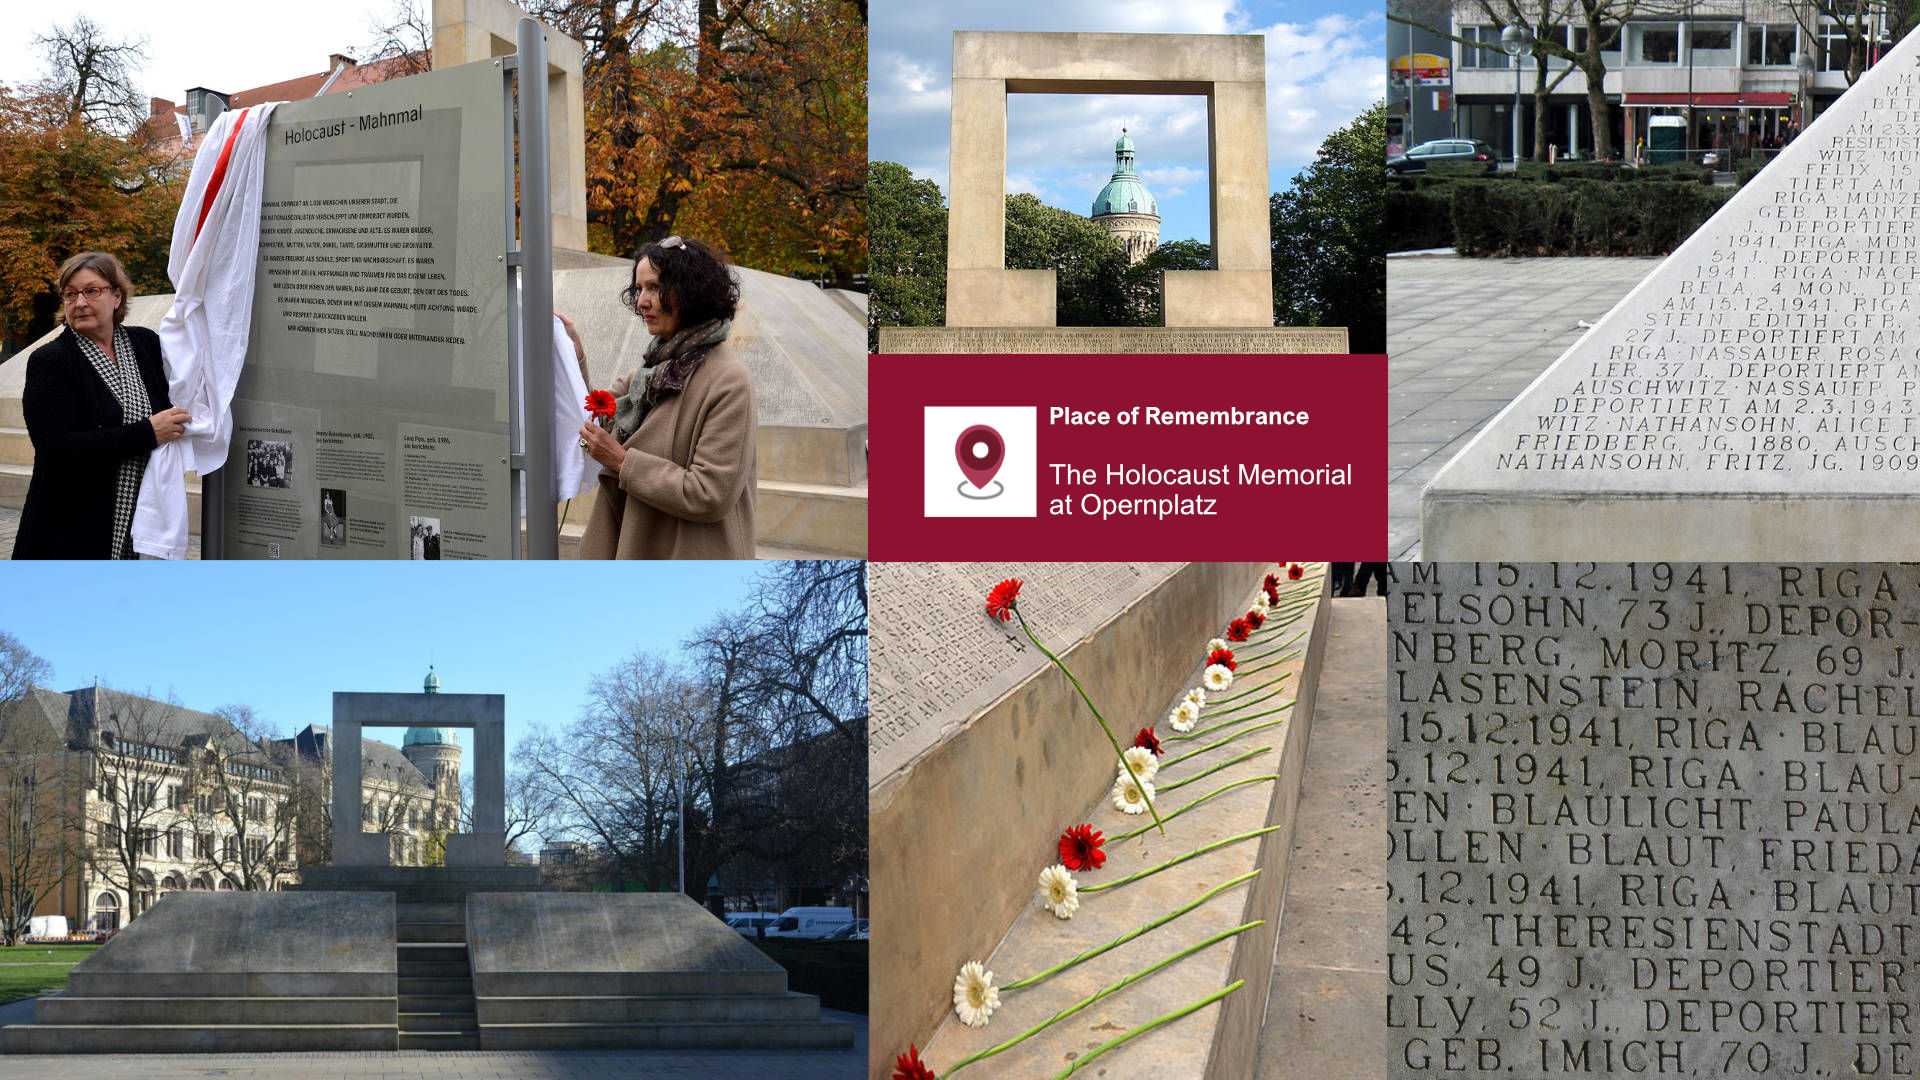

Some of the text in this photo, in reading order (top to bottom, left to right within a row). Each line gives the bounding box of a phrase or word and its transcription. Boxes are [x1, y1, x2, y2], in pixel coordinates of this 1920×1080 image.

[1873, 98, 1920, 109] BET
[285, 120, 346, 145] Holocaust
[359, 104, 422, 131] Mahnmal
[1846, 124, 1873, 135] AM
[1818, 150, 1865, 161] WITZ
[1890, 165, 1912, 176] 15
[1790, 177, 1904, 190] TIERT AM
[1774, 191, 1827, 204] RIGA
[1826, 206, 1920, 219] BLANKE
[1779, 220, 1915, 234] DEPORTIER
[1794, 236, 1847, 249] RIGA
[1867, 234, 1916, 249] MÜN
[1711, 250, 1737, 263] 54
[1782, 250, 1918, 264] DEPORTIER
[1774, 266, 1834, 280] RIGA
[1858, 266, 1920, 280] NACH
[1771, 282, 1782, 295] 4
[1663, 297, 1697, 311] AM
[1853, 298, 1912, 312] RIGA
[1749, 313, 1829, 328] EDITH
[1625, 329, 1655, 343] 27
[1702, 329, 1862, 345] DEPORTIERT
[1873, 330, 1906, 345] AM
[1609, 346, 1668, 361] RIGA
[1839, 346, 1902, 361] ROSA
[1655, 362, 1685, 378] 37
[1728, 362, 1886, 379] DEPORTIERT
[1572, 380, 1727, 396] AUSCHWITZ
[1553, 397, 1731, 414] DEPORTIERT
[1745, 398, 1781, 414] AM
[1537, 415, 1599, 432] WITZ
[1816, 417, 1890, 433] ALICE
[1698, 435, 1735, 452] JG.
[1834, 435, 1920, 452] AUSCH
[1808, 453, 1844, 471] JG.
[1859, 454, 1920, 471] 1909
[1472, 562, 1750, 599] 15.12.1941,
[1779, 565, 1897, 602] RIGA
[1387, 591, 1920, 639] ELSOHN, 73 J., DEPOR-
[1391, 630, 1576, 670] NBERG,
[1600, 636, 1792, 677] MORITZ,
[1816, 645, 1863, 676] 69
[1396, 670, 1920, 717] LASENSTEIN, RACHEL
[1399, 711, 1917, 756] 15.12.1941, RIGA BLAU
[1629, 755, 1742, 790] RIGA
[1393, 790, 1450, 824] EN
[1490, 792, 1763, 833] BLAULICHT,
[1567, 833, 1737, 873] BLAUT,
[1619, 874, 1732, 910] RIGA
[1391, 913, 1914, 956] 42, THERESIENSTADT
[1387, 953, 1462, 990] US,
[1486, 955, 1541, 988] 49
[1566, 956, 1606, 992] J.,
[1508, 997, 1561, 1030] 52
[1583, 999, 1620, 1034] J.,
[1643, 999, 1920, 1035] DEPORTIER
[1403, 1037, 1913, 1077] GEB. IMICH, 70 J., DE
